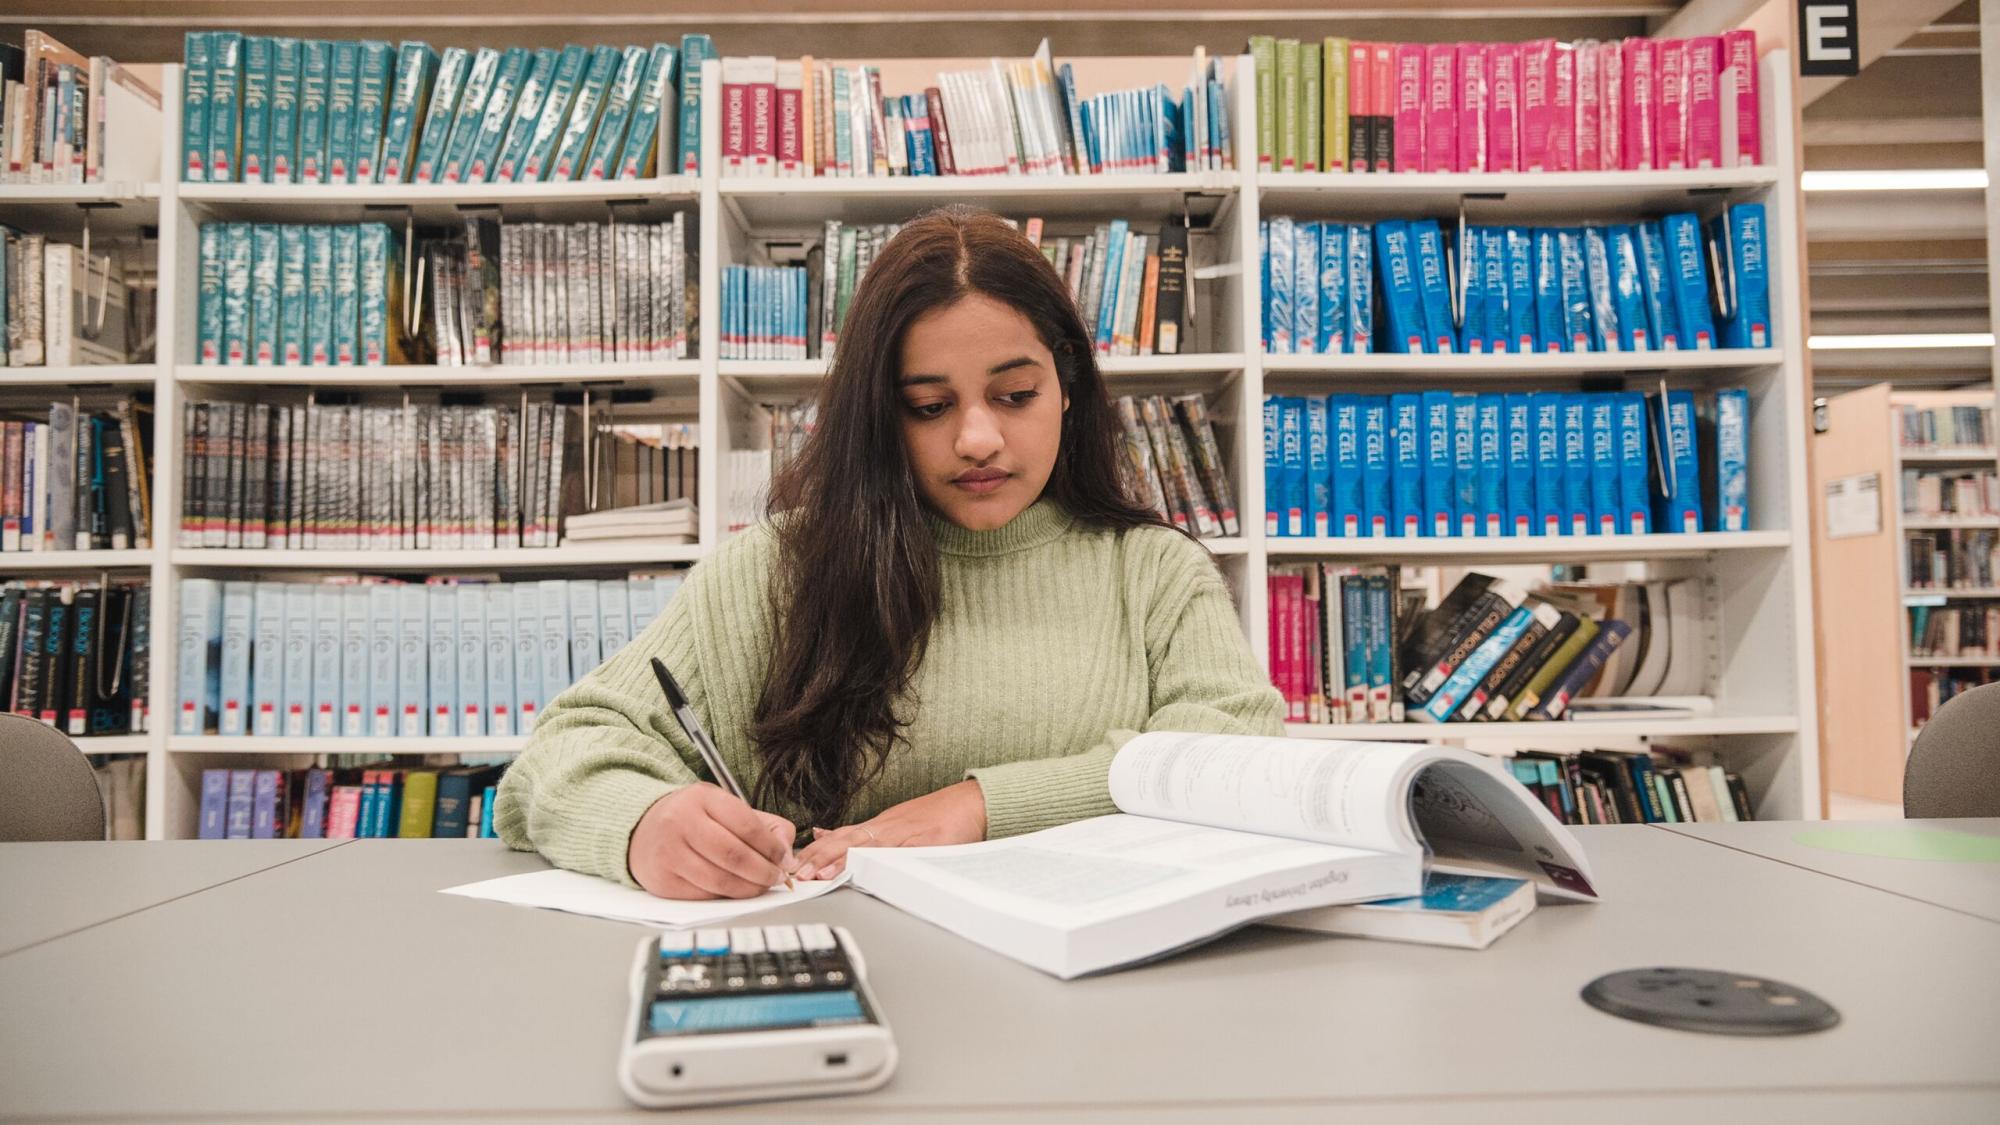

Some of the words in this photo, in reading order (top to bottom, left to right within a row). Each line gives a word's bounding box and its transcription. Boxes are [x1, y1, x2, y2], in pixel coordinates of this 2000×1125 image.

[1806, 5, 1851, 60] E
[187, 69, 208, 104] Life
[214, 68, 235, 104] Life
[246, 73, 267, 108] Life
[273, 75, 296, 111] Life
[303, 76, 325, 112] Life
[333, 77, 354, 113] Life
[360, 77, 381, 113] Life
[729, 87, 743, 153] BIOMETRY
[754, 87, 769, 152] BIOMETRY
[782, 93, 797, 156] BIOMETRY
[183, 613, 203, 650] Life
[224, 614, 246, 650] Life
[259, 616, 281, 653] Life
[288, 616, 310, 654] Life
[317, 617, 339, 654] Life
[346, 617, 367, 654] Life
[374, 617, 396, 654] Life
[402, 617, 423, 654] Life
[432, 617, 453, 655] Life
[460, 617, 481, 654] Life
[489, 617, 509, 654] Life
[517, 616, 538, 653] Life
[543, 614, 563, 651] Life
[573, 613, 594, 651] Life
[604, 613, 625, 650] Life
